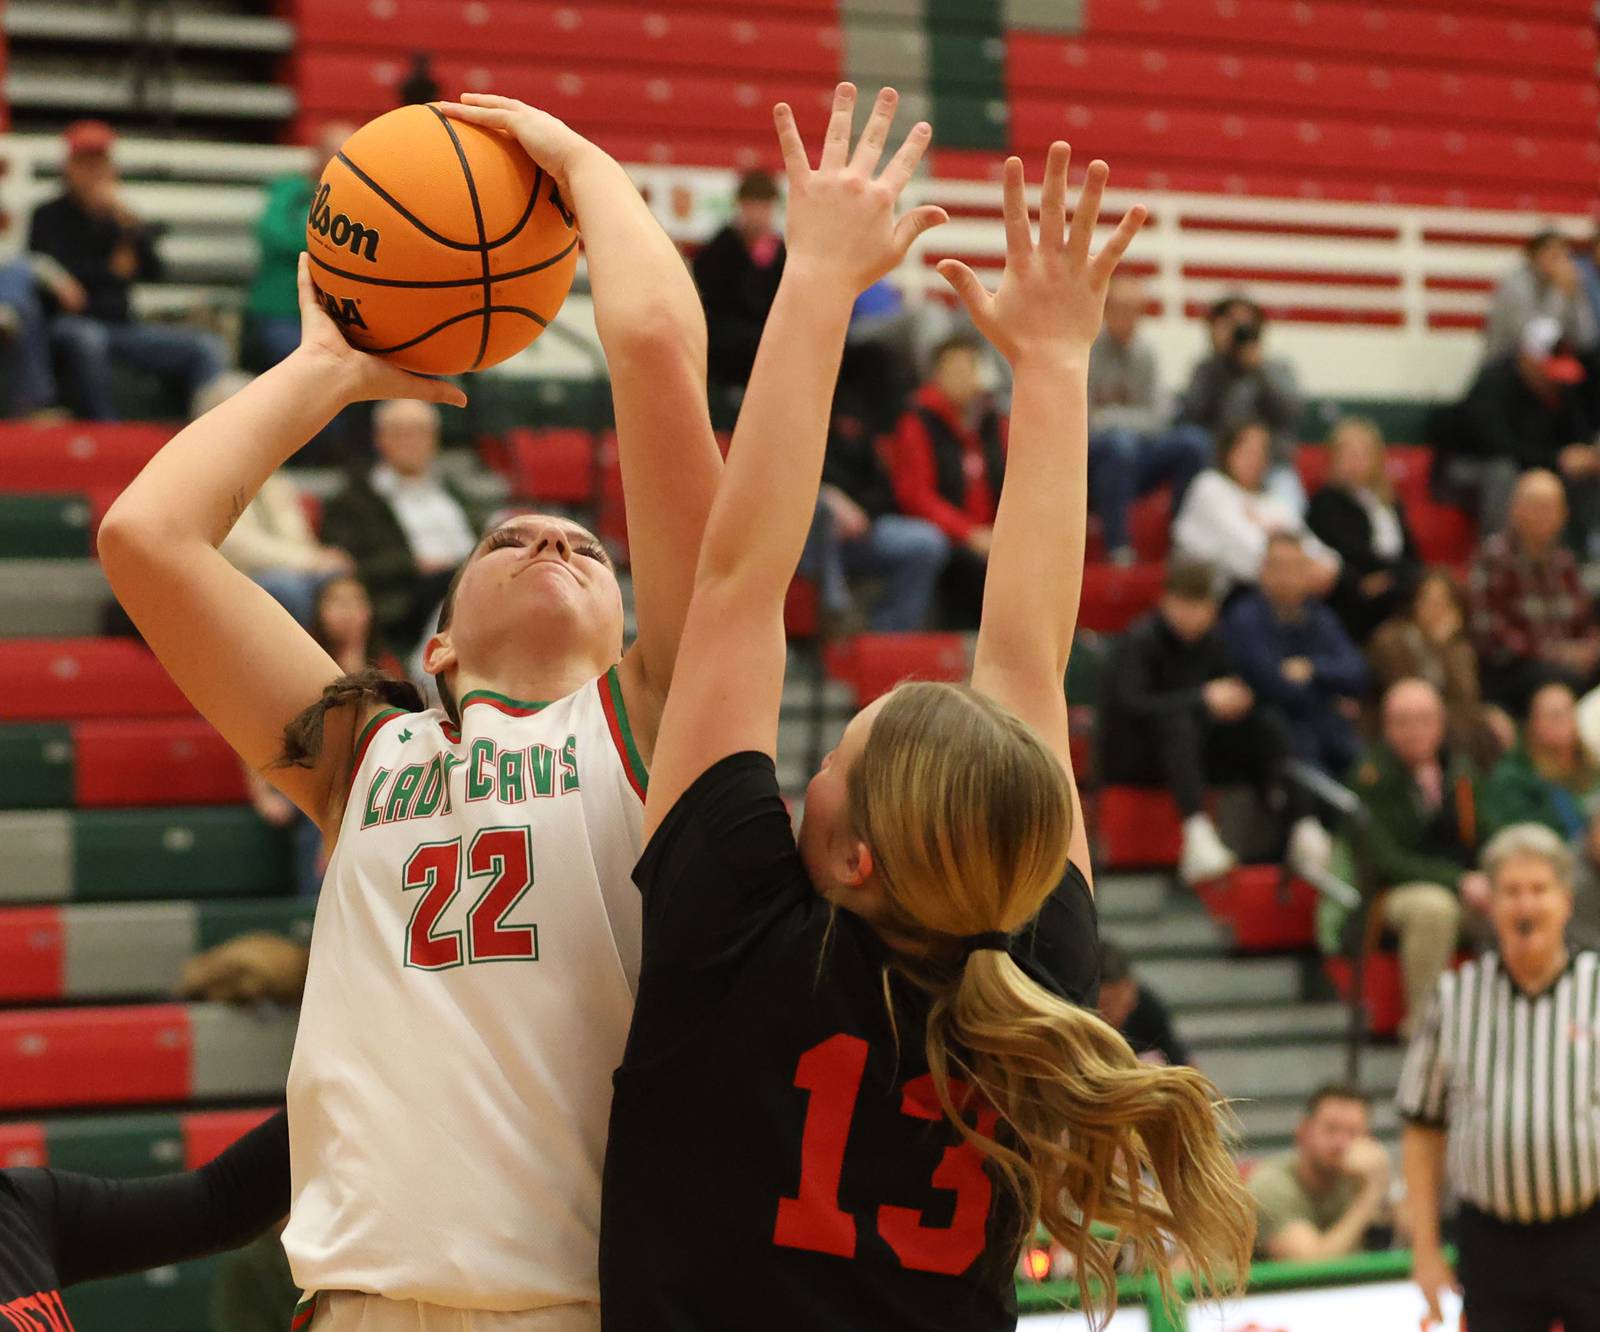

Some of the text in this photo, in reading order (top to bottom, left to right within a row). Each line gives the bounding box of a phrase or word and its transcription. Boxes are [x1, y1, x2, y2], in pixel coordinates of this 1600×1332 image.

[465, 734, 581, 805] CAVS
[402, 824, 539, 972] 22
[773, 1032, 1001, 1276] 13
